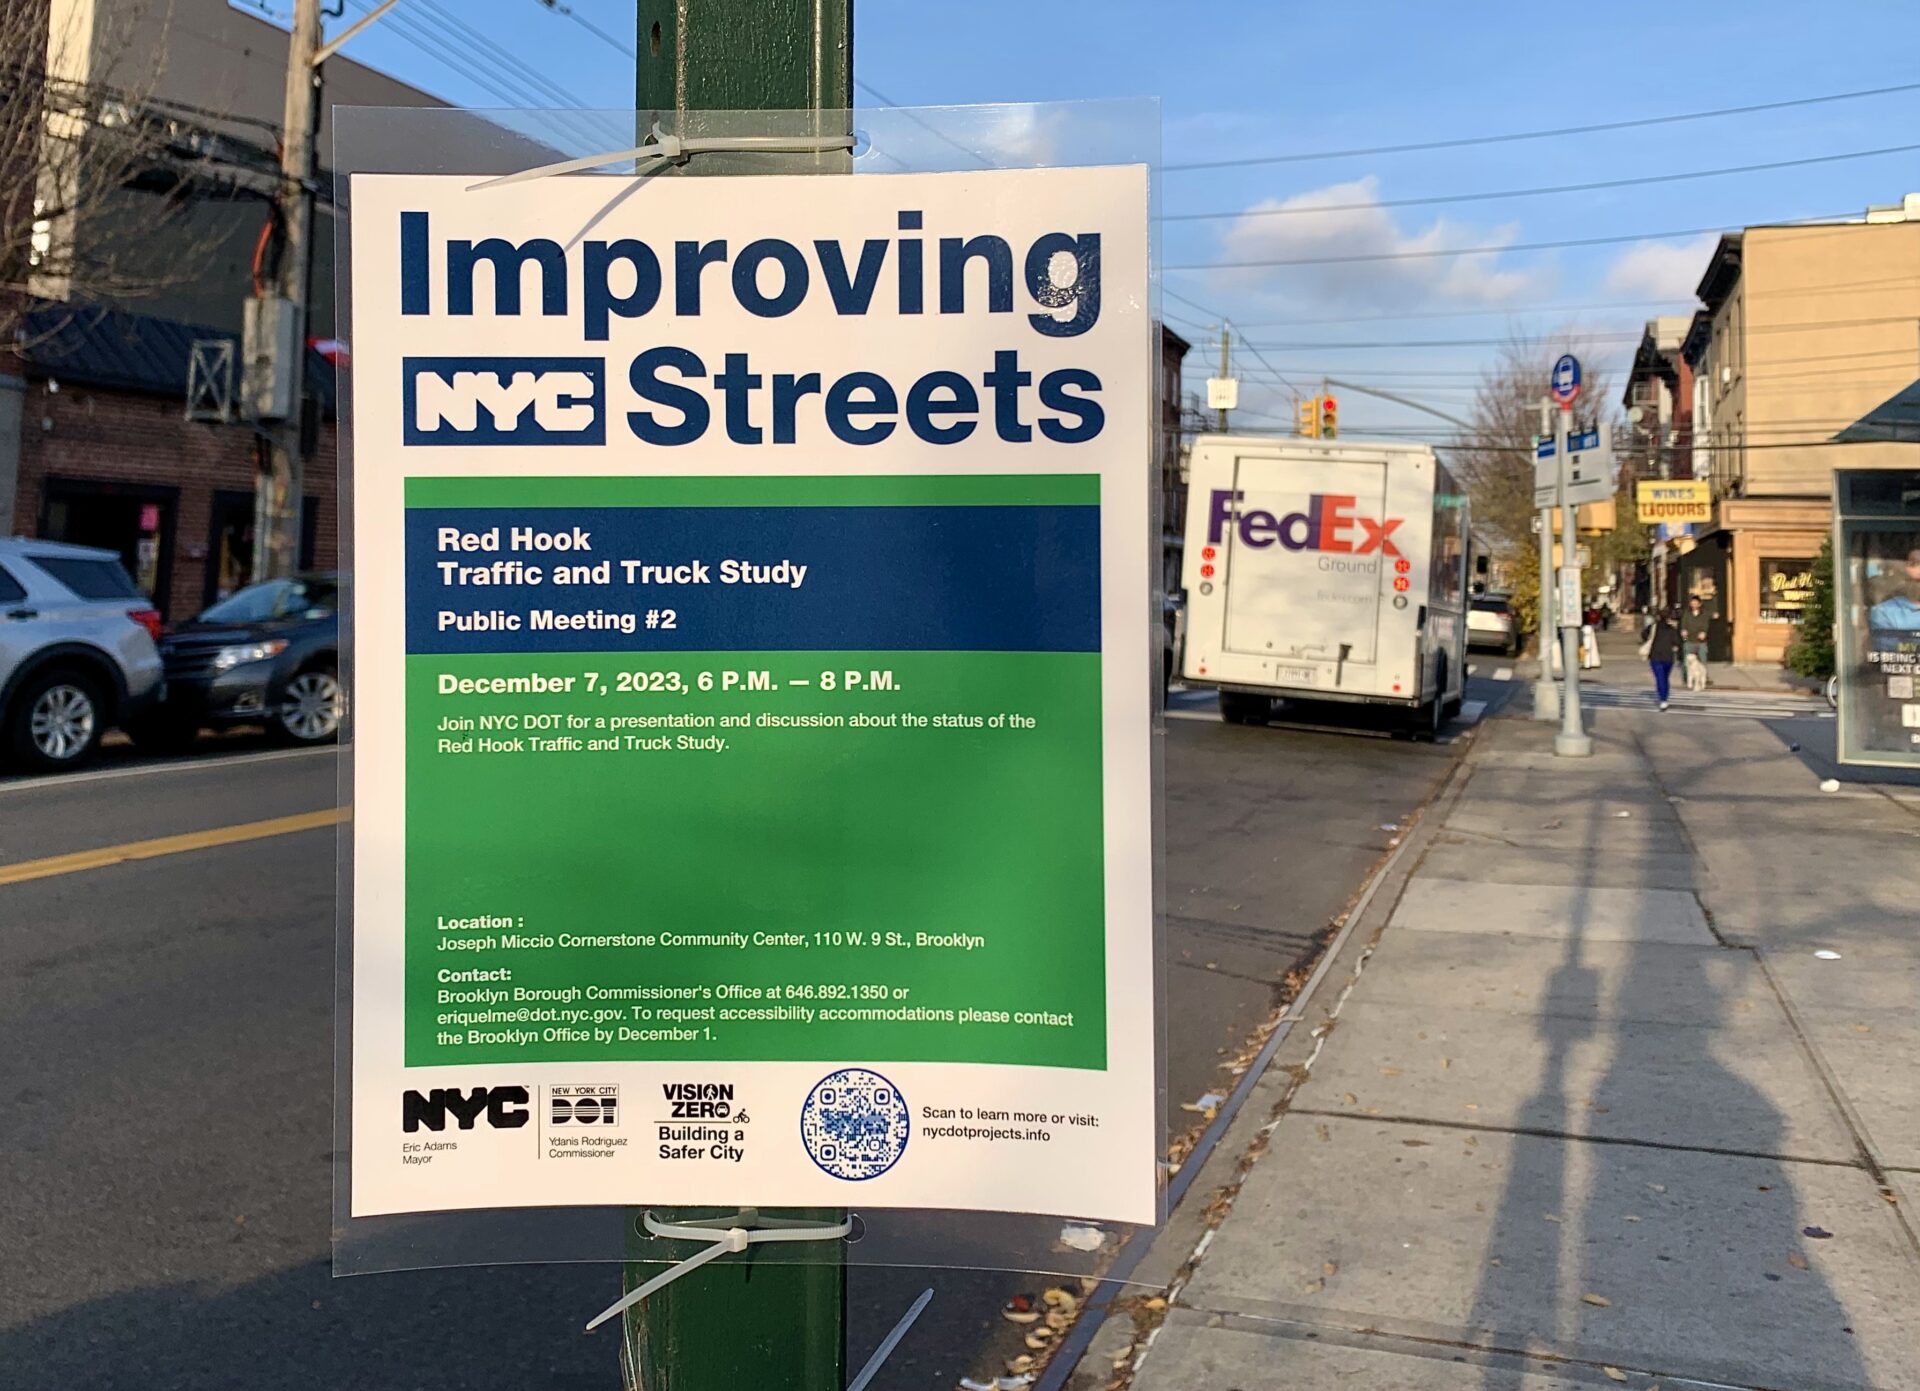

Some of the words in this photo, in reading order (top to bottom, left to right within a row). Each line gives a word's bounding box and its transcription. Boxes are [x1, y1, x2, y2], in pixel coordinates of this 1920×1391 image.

[399, 209, 1101, 342] Improving
[415, 371, 595, 432] NYC
[627, 346, 1105, 445] Streets
[1652, 489, 1695, 499] WINES
[1642, 503, 1706, 517] LIQUORS
[1208, 489, 1405, 557] FedEx
[437, 527, 500, 552] Red
[510, 526, 592, 551] Hook
[437, 561, 543, 585] Traffic
[552, 560, 611, 585] and
[620, 559, 711, 584] Truck
[719, 559, 808, 589] Study
[1318, 556, 1377, 574] Ground
[437, 610, 522, 631] Public
[529, 609, 636, 634] Meeting
[645, 609, 677, 629] #2
[1881, 651, 1916, 664] BEING
[438, 673, 576, 694] December
[583, 672, 607, 696] 7,
[616, 671, 689, 696] 2023,
[697, 671, 713, 692] 6
[722, 671, 778, 692] P.M.
[820, 671, 836, 691] 8
[844, 671, 901, 691] P.M.
[437, 716, 475, 731] Join
[480, 715, 519, 730] NYC
[523, 714, 562, 730] DOT
[567, 713, 591, 729] for
[595, 717, 606, 729] a
[610, 713, 714, 731] presentation
[719, 712, 751, 728] and
[756, 712, 844, 728] discussion
[849, 712, 897, 728] about
[901, 712, 928, 728] the
[932, 714, 984, 728] status
[988, 713, 1005, 728] of
[1009, 714, 1036, 729] the
[438, 738, 473, 753] Red
[478, 737, 524, 752] Hook
[528, 736, 583, 752] Traffic
[587, 736, 620, 751] and
[624, 735, 672, 750] Truck
[676, 735, 730, 753] Study.
[437, 915, 513, 930] Location
[437, 935, 497, 953] Joseph
[501, 934, 554, 949] Miccio
[558, 933, 656, 948] Cornerstone
[660, 931, 749, 949] Community
[753, 931, 809, 948] Center,
[813, 932, 842, 946] 110
[846, 931, 867, 946] W.
[871, 931, 881, 947] 9
[885, 931, 911, 949] St.,
[916, 932, 985, 950] Brooklyn
[437, 968, 512, 983] Contact:
[438, 988, 509, 1005] Brooklyn
[514, 986, 581, 1003] Borough
[586, 985, 711, 1001] Commissioner's
[716, 985, 762, 1000] Office
[766, 986, 782, 999] at
[785, 985, 888, 1000] 646.892.1350
[892, 988, 910, 999] or
[437, 1007, 627, 1026] eriquelme@dot.nyc.gov.
[632, 1006, 652, 1020] To
[656, 1006, 715, 1024] request
[719, 1006, 815, 1023] accessibility
[819, 1006, 954, 1021] accommodations
[958, 1007, 1010, 1025] please
[1014, 1010, 1074, 1026] contact
[437, 1031, 463, 1045] the
[468, 1028, 539, 1046] Brooklyn
[543, 1027, 590, 1042] Office
[594, 1027, 614, 1044] by
[618, 1026, 699, 1041] December
[703, 1027, 717, 1041] 1.
[552, 1087, 570, 1095] NEW
[663, 1084, 734, 1101] VISION
[403, 1085, 529, 1133] NYC
[552, 1098, 617, 1124] DOT
[671, 1102, 730, 1118] ZERO
[922, 1106, 956, 1120] Scan
[960, 1107, 973, 1120] to
[977, 1107, 1010, 1121] learn
[1013, 1111, 1047, 1123] more
[1051, 1113, 1065, 1124] or
[1068, 1114, 1099, 1128] visit:
[549, 1137, 579, 1146] Ydanis
[582, 1137, 628, 1148] Rodriguez
[659, 1126, 729, 1144] Building
[734, 1130, 744, 1142] a
[922, 1125, 1051, 1142] nycdotprojects.info
[403, 1143, 421, 1152] Eric
[424, 1142, 457, 1151] Adams
[549, 1149, 615, 1158] Commissioner
[659, 1144, 705, 1160] Safer
[712, 1144, 744, 1162] City
[403, 1155, 432, 1165] Mayor
